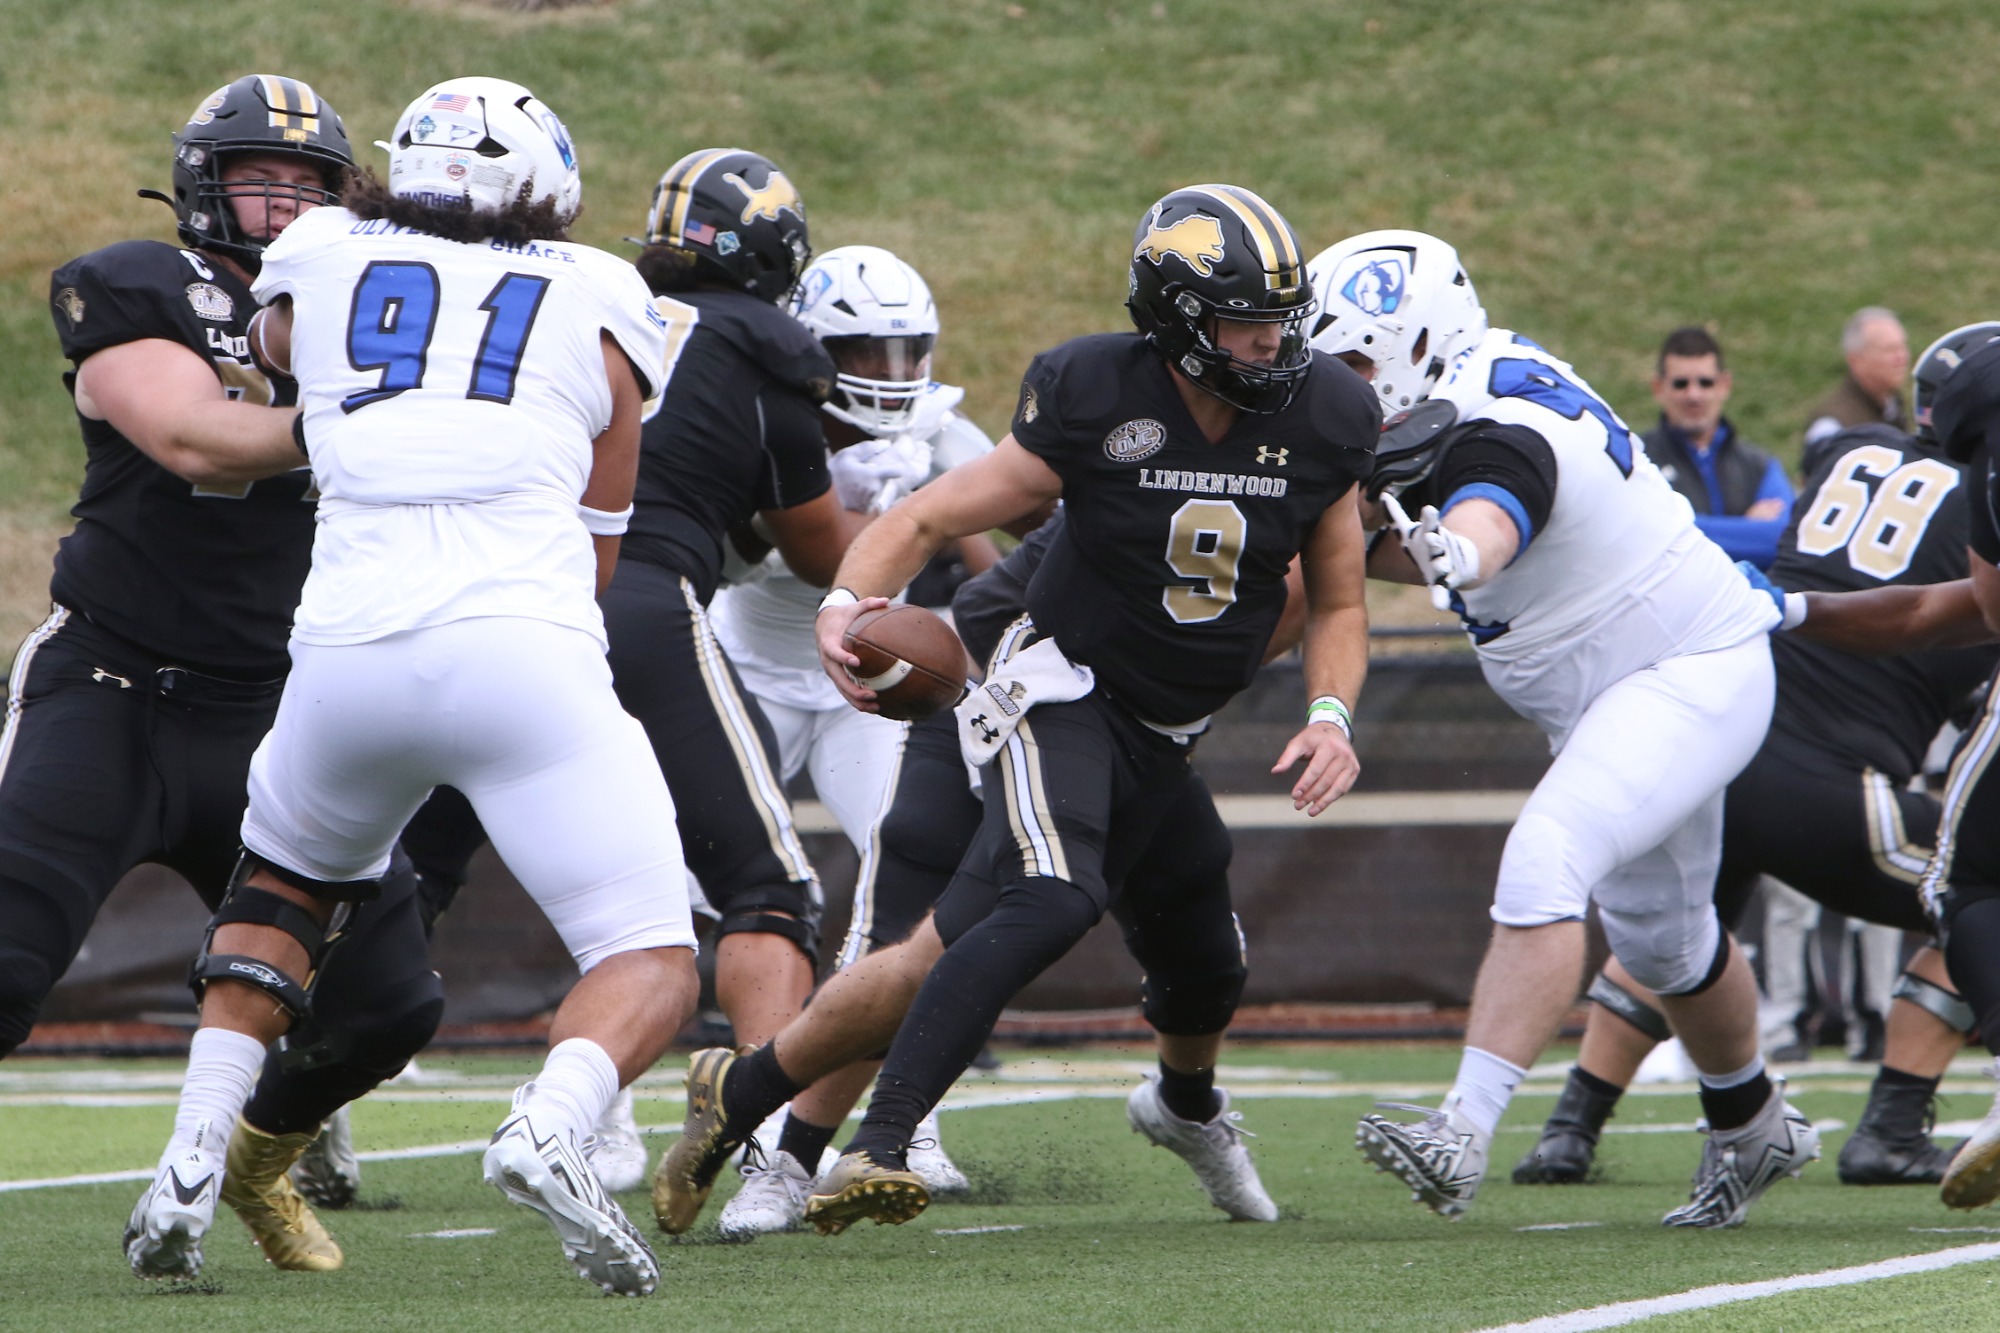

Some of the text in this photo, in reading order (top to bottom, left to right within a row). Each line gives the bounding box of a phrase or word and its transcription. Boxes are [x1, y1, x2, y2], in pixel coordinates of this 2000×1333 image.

[340, 260, 553, 415] 91
[1116, 427, 1157, 455] OVC
[1138, 468, 1288, 498] LINDENWOOD
[1161, 498, 1248, 624] 9
[1797, 444, 1960, 581] 68
